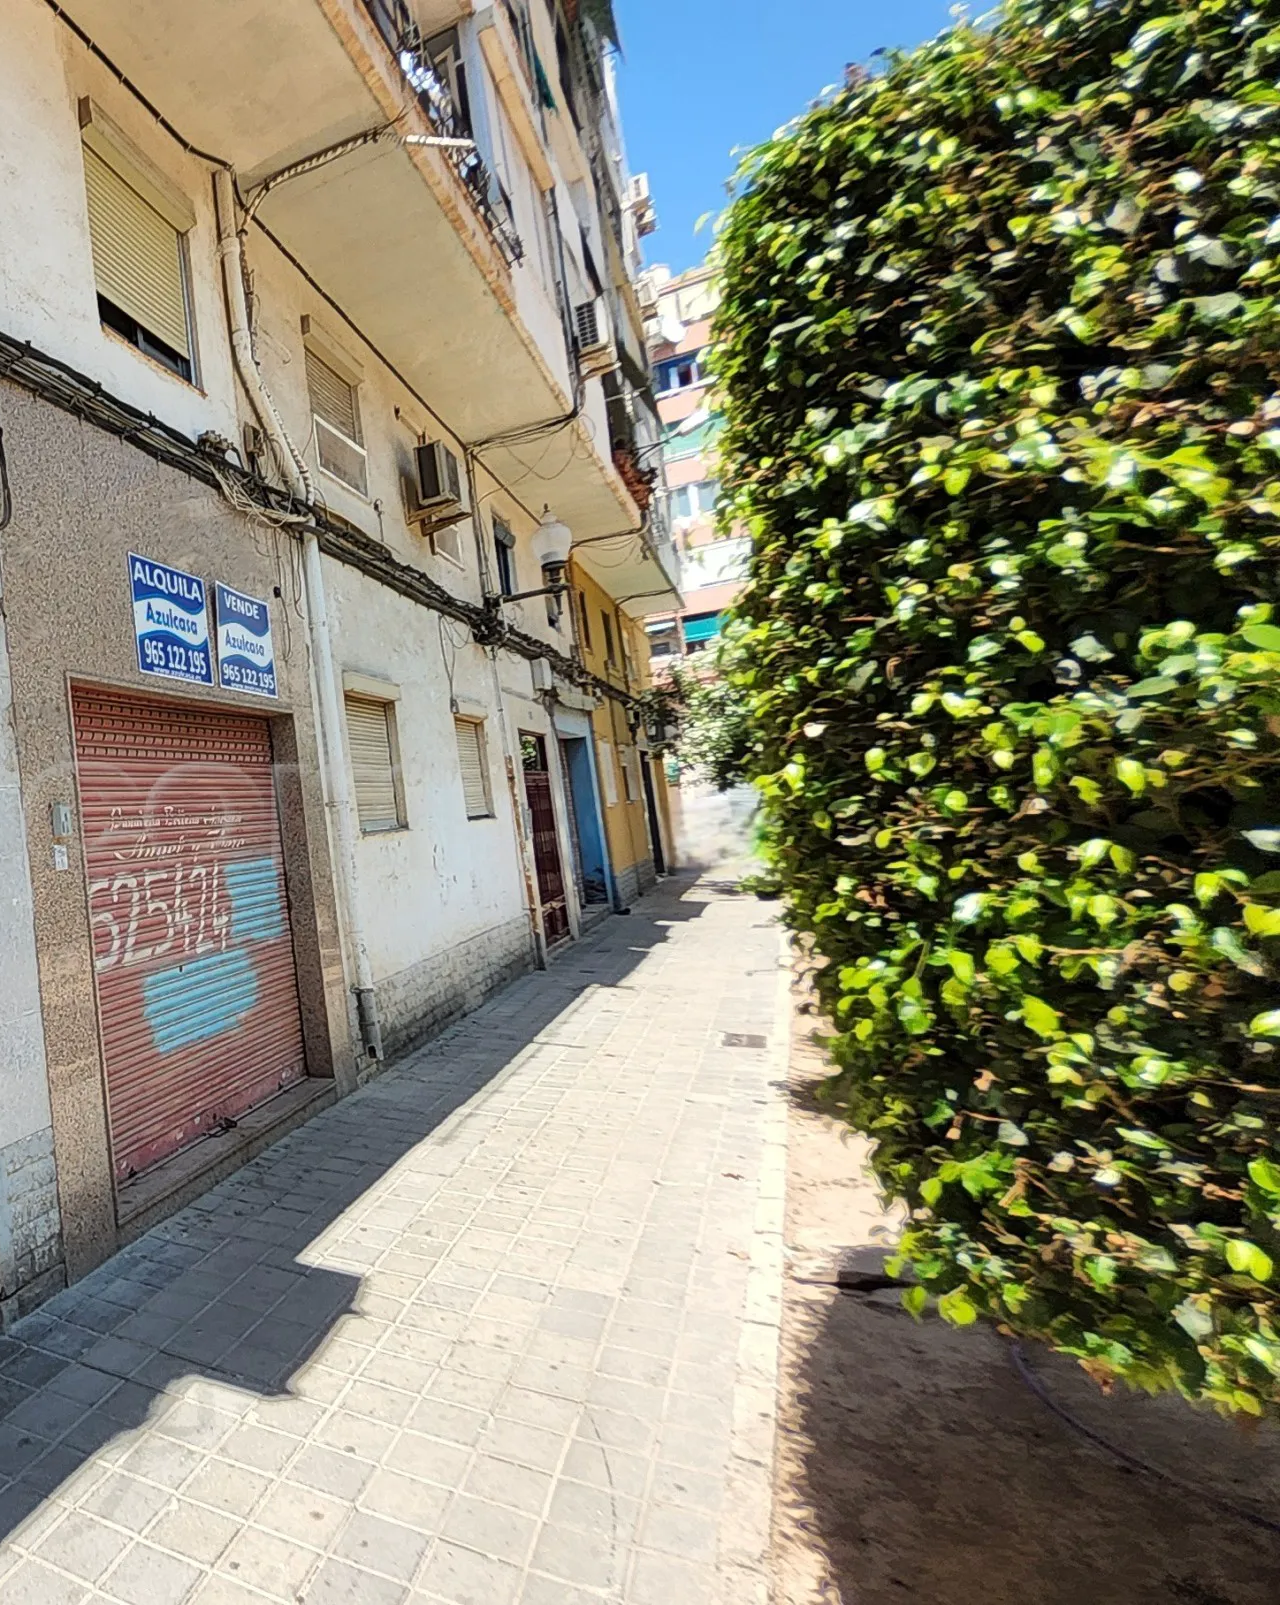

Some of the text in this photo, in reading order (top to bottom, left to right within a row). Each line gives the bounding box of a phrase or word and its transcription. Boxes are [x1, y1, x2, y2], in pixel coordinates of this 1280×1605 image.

[134, 561, 202, 602] ALQUILA
[146, 602, 198, 635] Azulcasa
[224, 592, 260, 619] VENDE
[144, 639, 207, 675] 965 122 195
[225, 629, 265, 656] Azulcasa
[223, 663, 274, 689] 965 122 195
